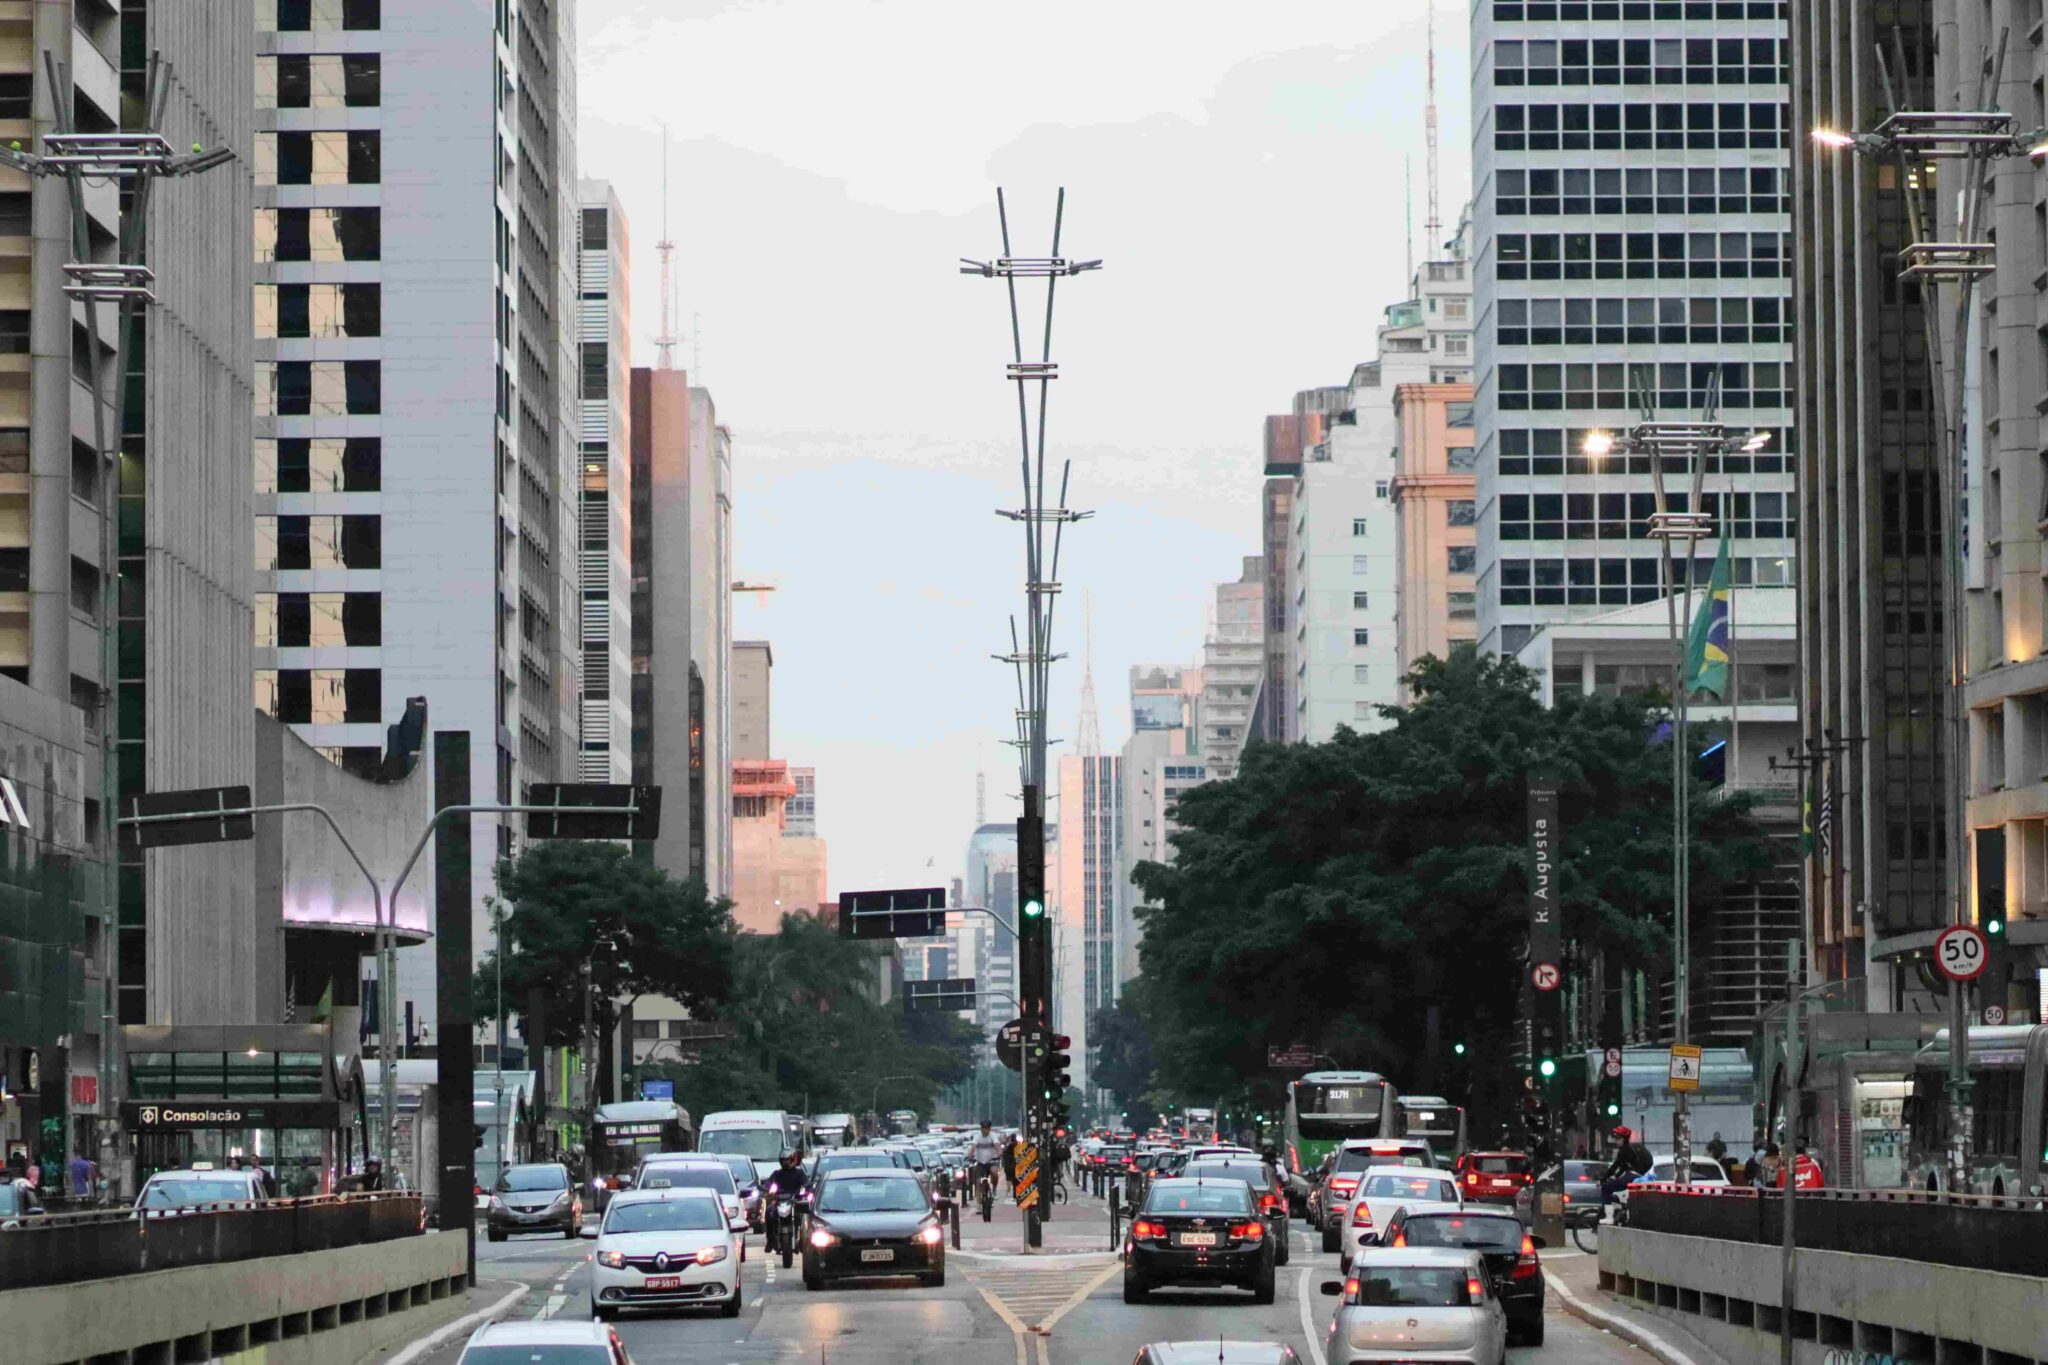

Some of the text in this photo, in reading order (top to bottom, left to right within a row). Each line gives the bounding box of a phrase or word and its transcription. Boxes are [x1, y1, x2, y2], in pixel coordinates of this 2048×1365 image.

[1533, 819, 1552, 900] Augusta
[1945, 937, 1979, 962] 50
[1987, 1009, 2002, 1020] 50
[1330, 1089, 1349, 1099] 917H
[162, 1109, 241, 1122] Consolação
